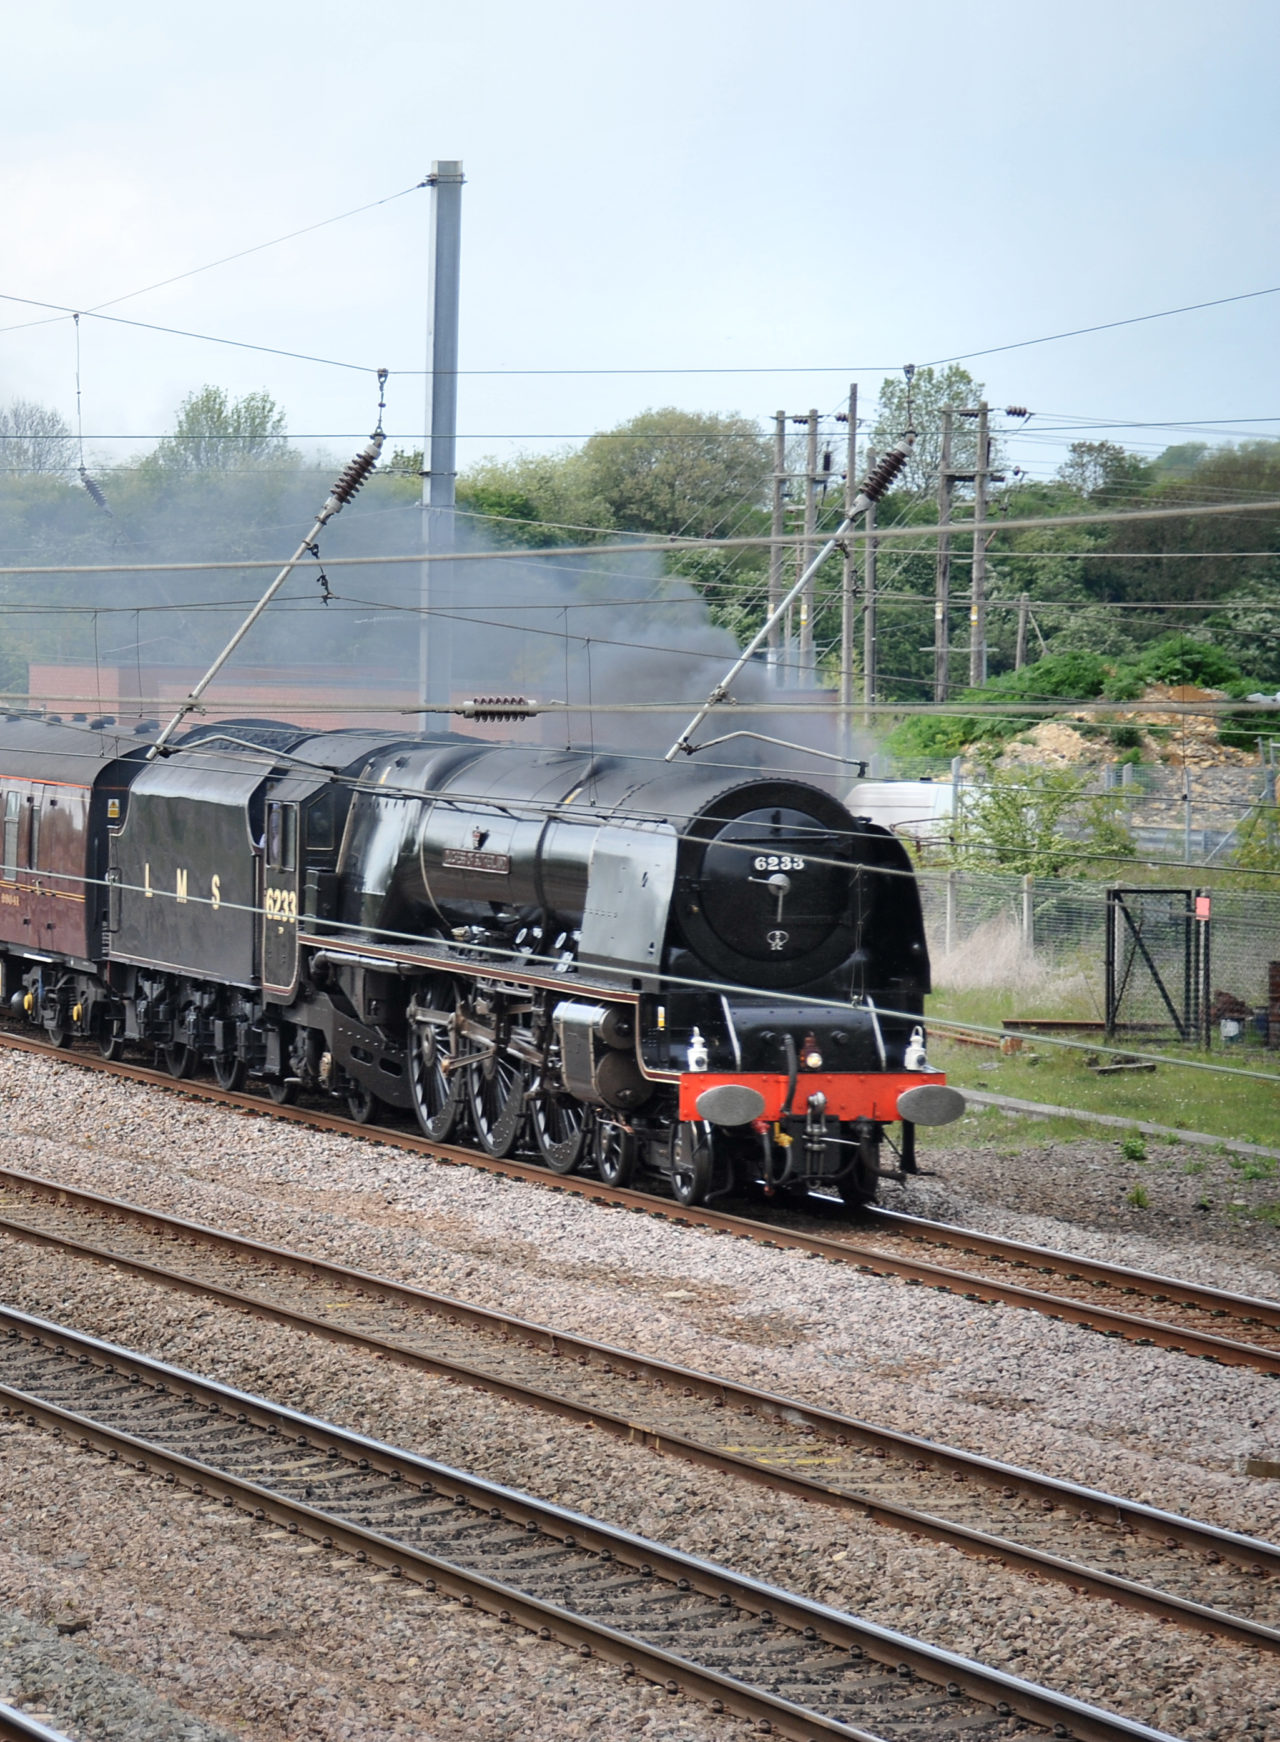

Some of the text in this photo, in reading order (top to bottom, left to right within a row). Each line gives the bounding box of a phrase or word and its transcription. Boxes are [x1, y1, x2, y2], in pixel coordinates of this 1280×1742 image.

[754, 856, 805, 871] 6233
[145, 863, 220, 910] L M S
[266, 887, 296, 923] 6233
